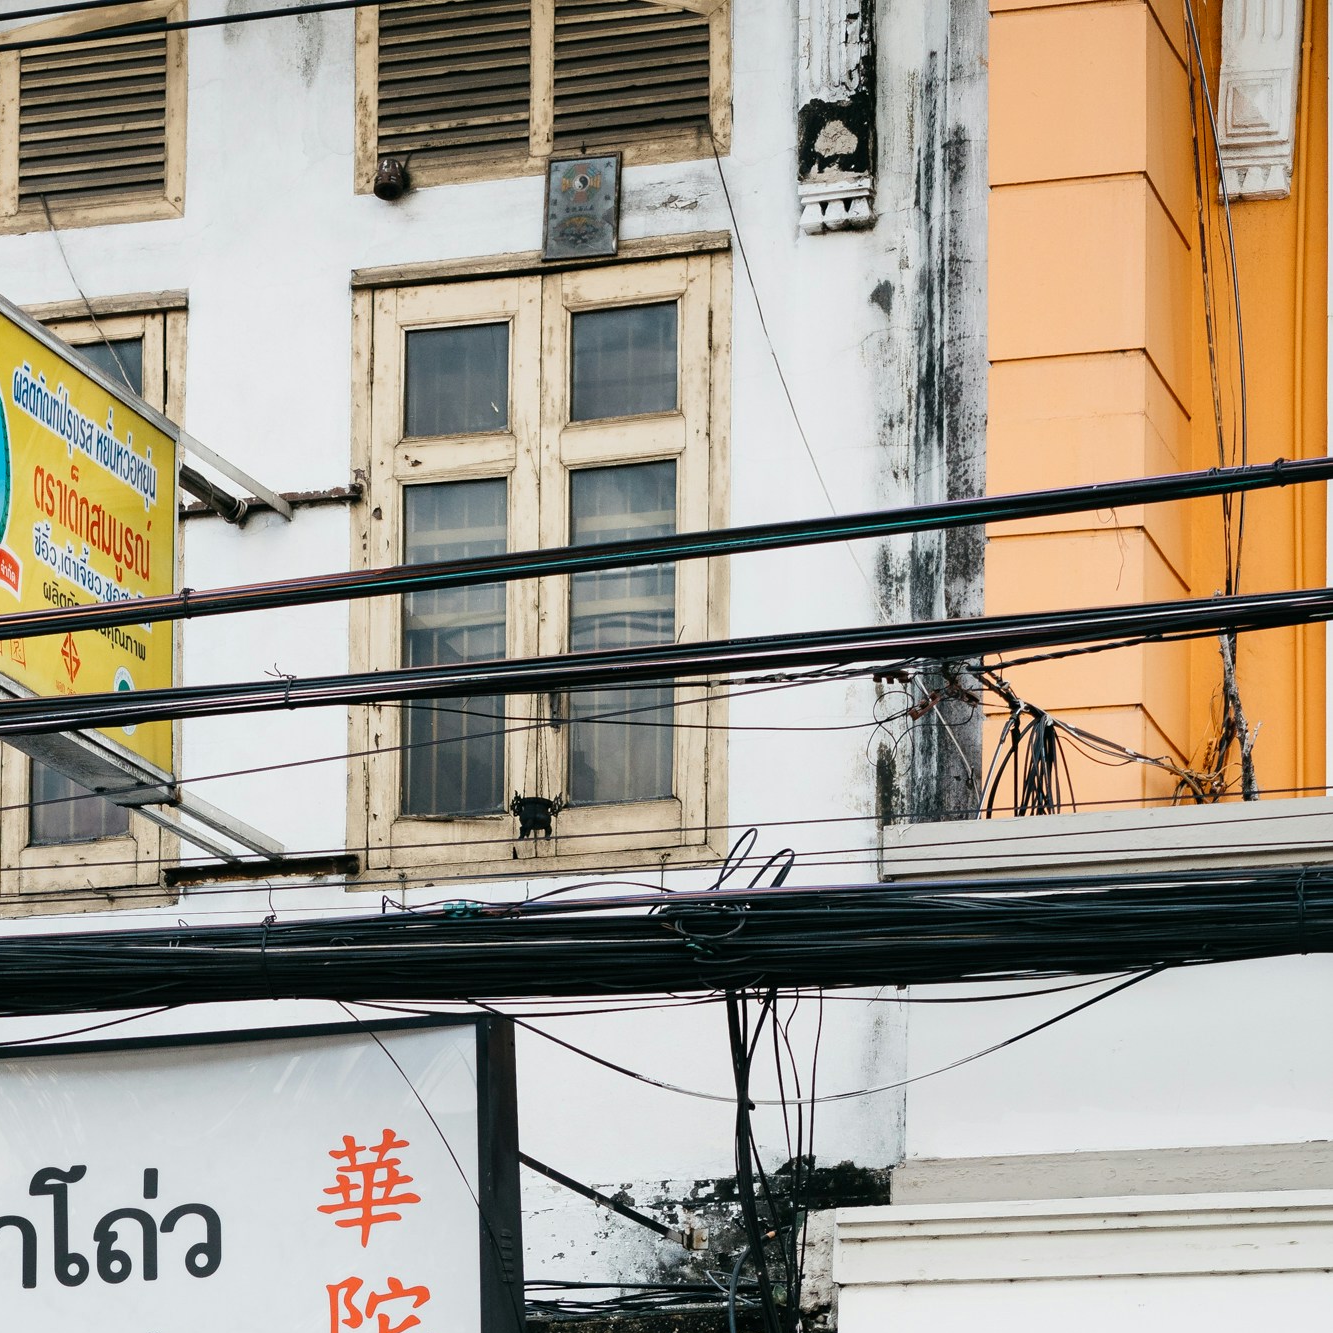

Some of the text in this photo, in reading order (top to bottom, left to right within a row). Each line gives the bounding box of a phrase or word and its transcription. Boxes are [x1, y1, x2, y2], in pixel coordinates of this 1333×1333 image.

[34, 465, 151, 582] ตราเด็กสมบูรณ์
